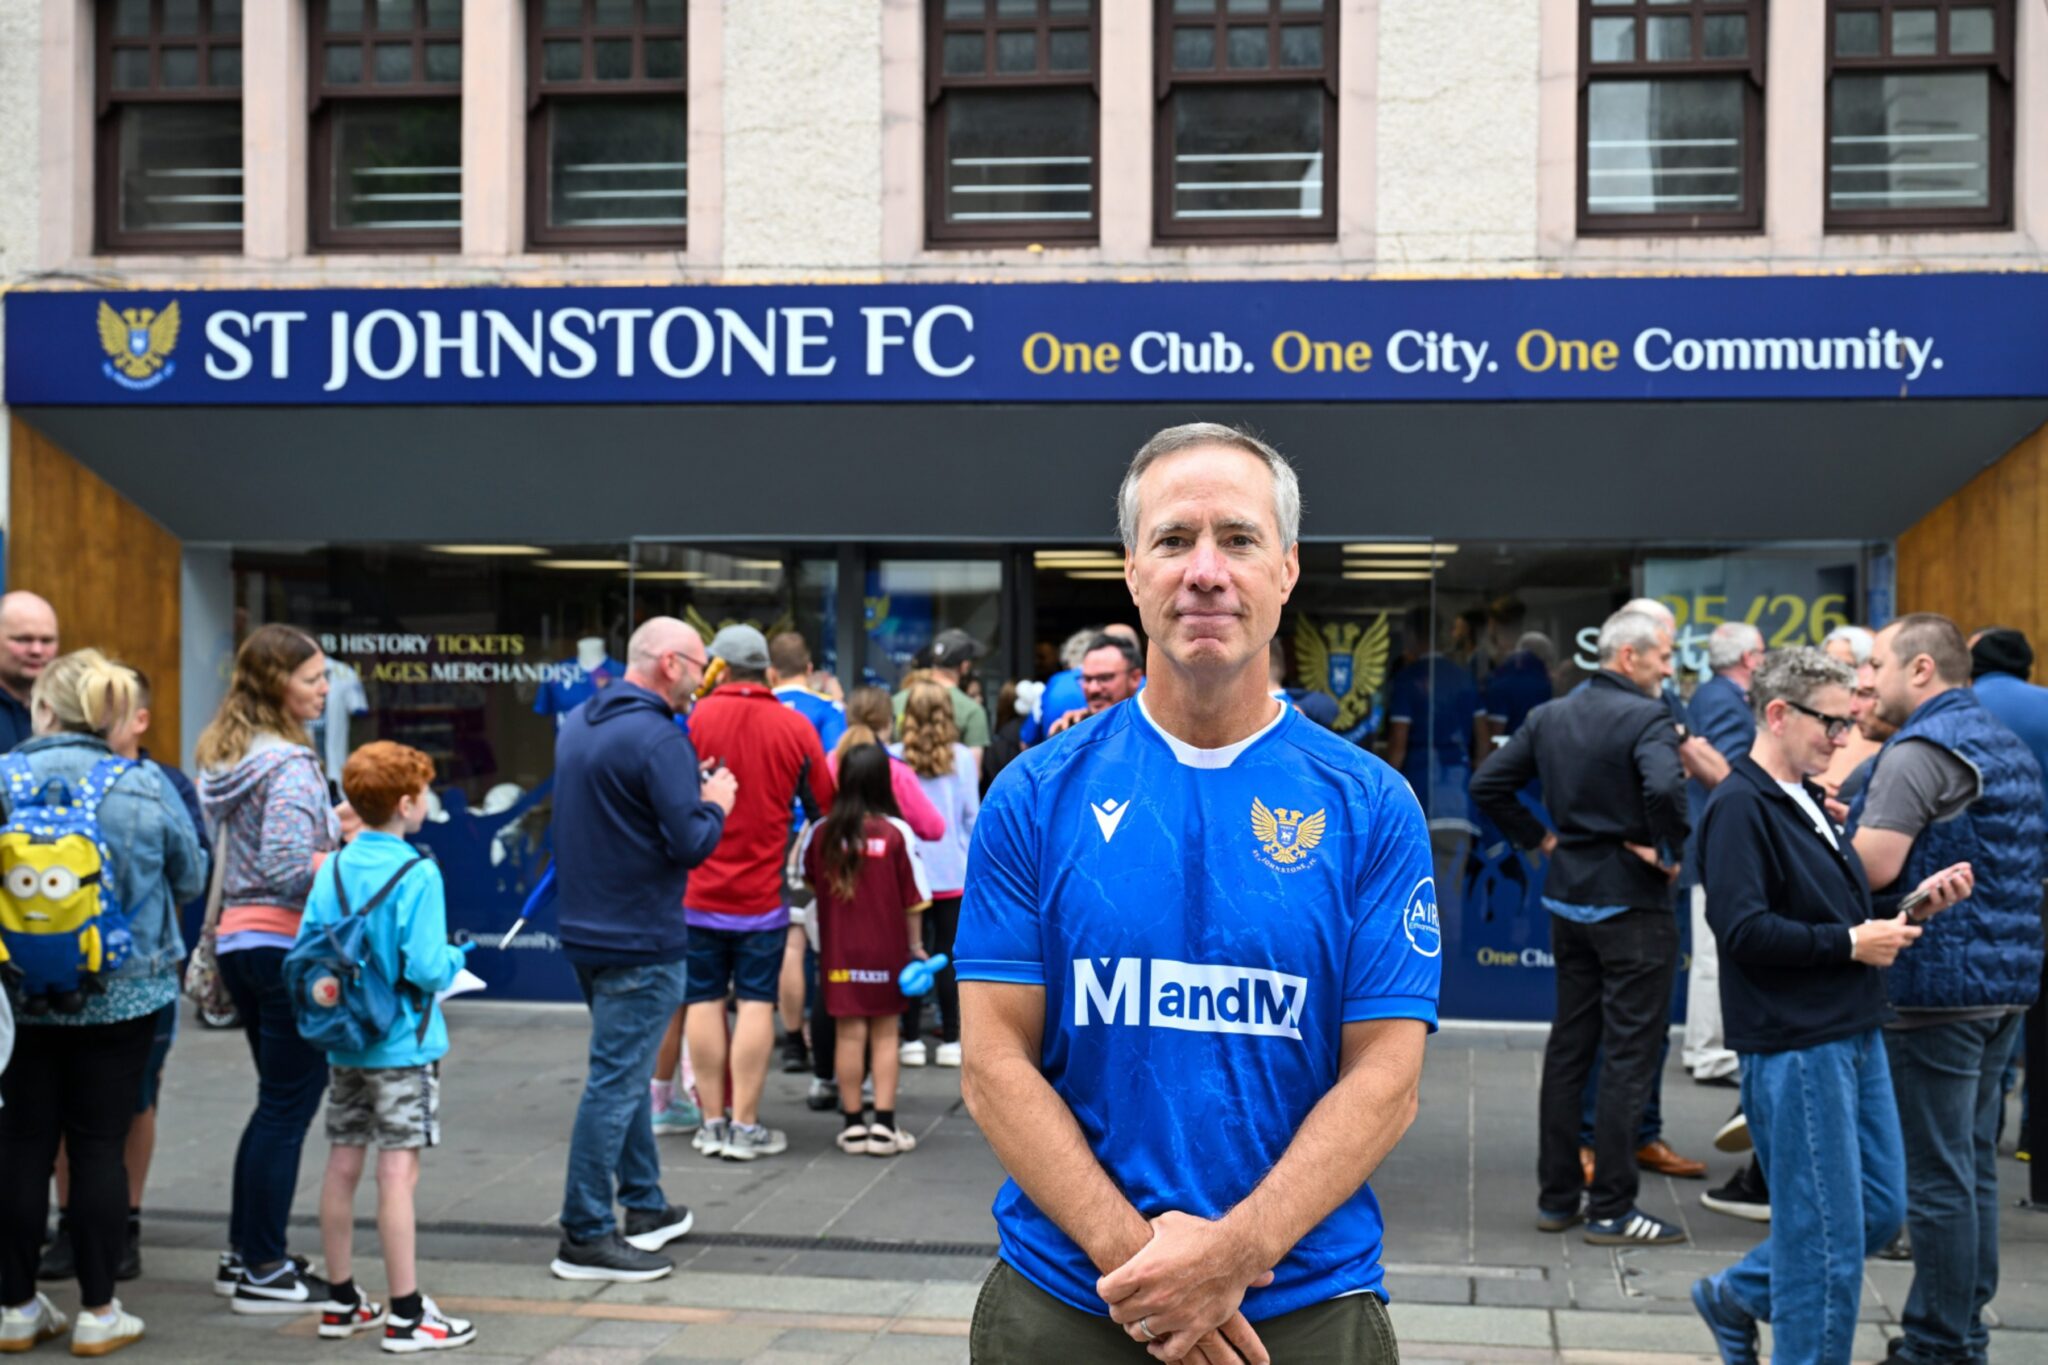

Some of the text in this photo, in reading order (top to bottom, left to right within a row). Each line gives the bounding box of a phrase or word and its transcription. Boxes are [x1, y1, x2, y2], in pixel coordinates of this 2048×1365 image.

[206, 304, 975, 391] ST JOHNSTONE FC
[1022, 327, 1944, 384] One Club. One City. One Community.
[340, 633, 428, 654] HISTORY
[436, 634, 524, 655] TICKETS
[431, 662, 587, 683] MERCHANDISE
[1477, 947, 1555, 967] One Clu
